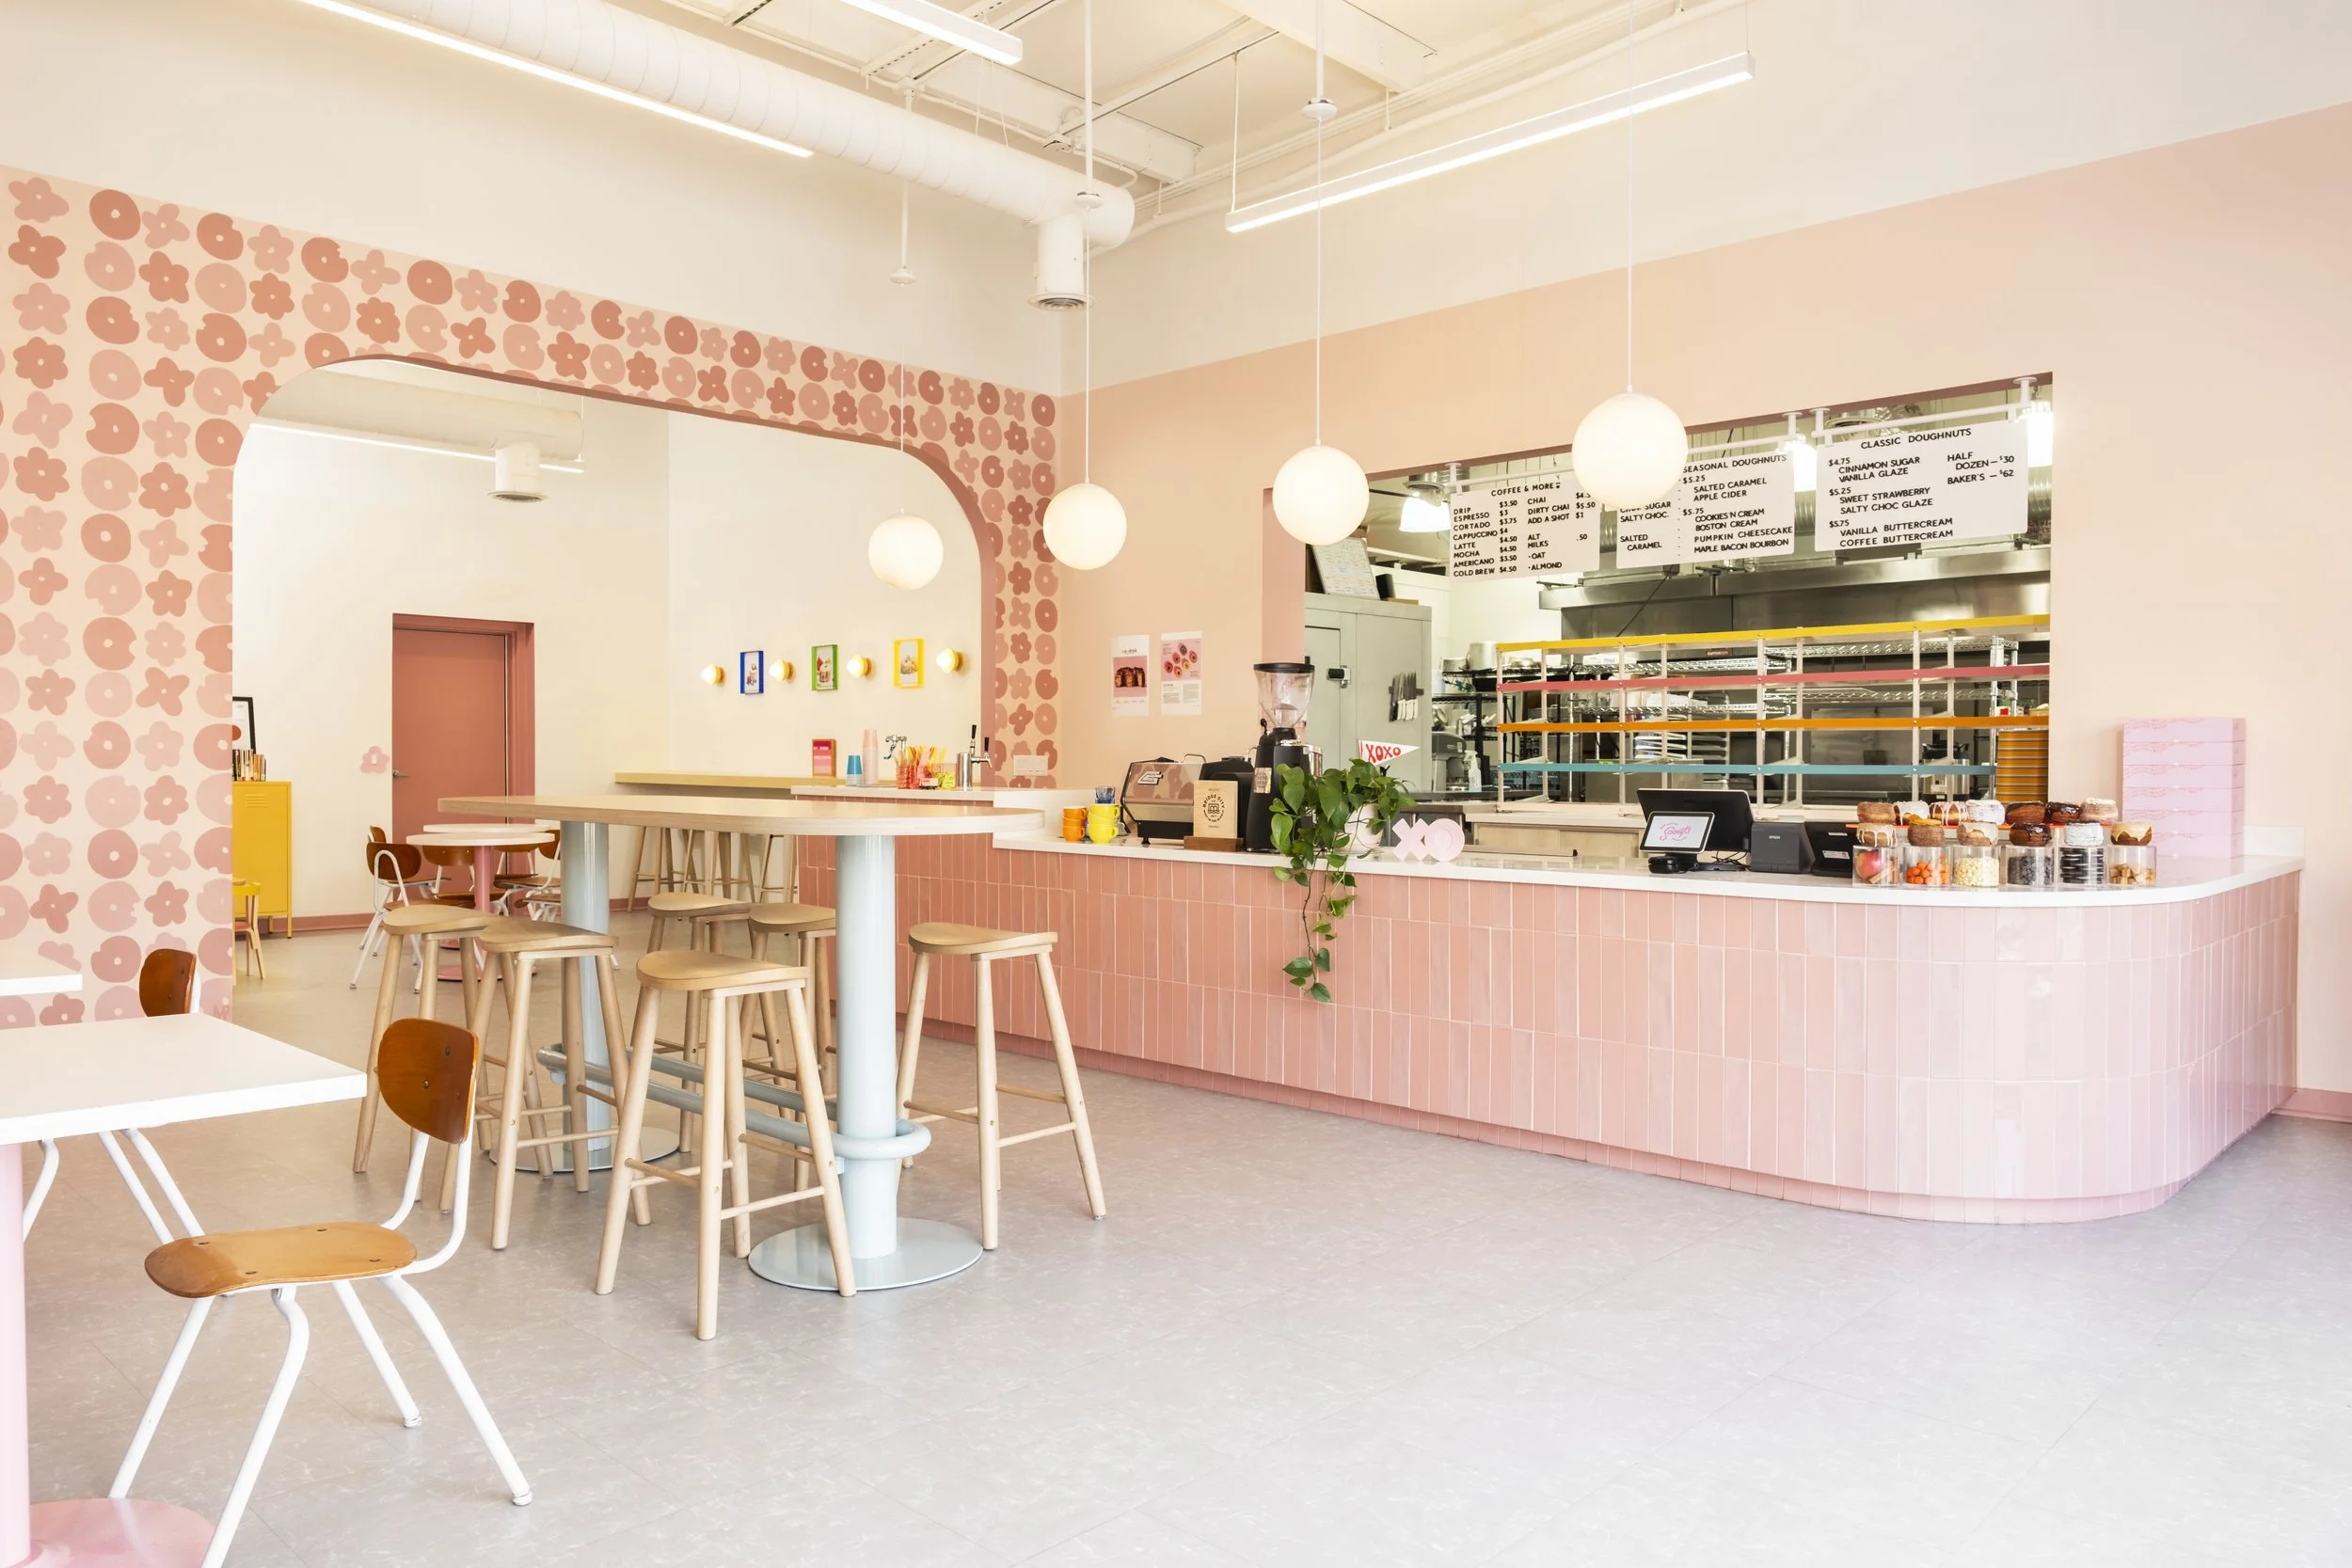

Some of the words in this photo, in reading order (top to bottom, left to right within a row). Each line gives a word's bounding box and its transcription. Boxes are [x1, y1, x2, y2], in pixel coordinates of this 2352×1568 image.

[1861, 436, 1901, 450] CLASSIC
[1908, 428, 1972, 444] DOUGHNUTS
[1828, 457, 1851, 467] $4.75
[1947, 451, 1973, 462] HALF
[1683, 462, 1728, 473] SEASONAL
[1732, 454, 1787, 467] DOUGHNUTS
[1838, 461, 1887, 474] CINNAMON
[1890, 456, 1920, 467] SUGAR
[1956, 459, 1989, 470] DOZEN
[1683, 475, 1706, 484] $5.25
[1839, 471, 1875, 483] VANILLA
[1879, 467, 1909, 478] GLAZE
[1947, 473, 1985, 485] BAKER'S
[1694, 483, 1725, 493] SALTED
[1727, 478, 1768, 489] CARAMEL
[1491, 486, 1521, 497] COFFEE
[1693, 493, 1718, 501] APPLE
[1722, 490, 1747, 499] CIDER
[1829, 487, 1851, 497] $5.25
[1839, 494, 1868, 504] SWEET
[1872, 487, 1931, 500] STRAWBERRY
[1528, 497, 1546, 505] CHAI
[1840, 504, 1868, 515] SALTY
[1871, 502, 1899, 512] CHOC
[1902, 498, 1933, 509] GLAZE
[1454, 507, 1471, 515] DRIP
[1528, 507, 1549, 515] DIRTY
[1576, 501, 1596, 510] $5.50
[1683, 508, 1704, 516] $5.75
[1454, 513, 1489, 523] ESPRESSO
[1620, 514, 1644, 523] SALTY
[1695, 513, 1728, 523] COOKIES
[1738, 508, 1765, 518] CREAM
[1454, 522, 1490, 531] CORTADO
[1695, 522, 1726, 531] BOSTON
[1730, 519, 1757, 528] CREAM
[1829, 519, 1850, 529] $5.75
[1840, 526, 1878, 537] VANILLA
[1883, 517, 1953, 532] BUTTERCREAM
[1454, 531, 1498, 541] CAPPUCCINO
[1620, 534, 1648, 543] SALTED
[1694, 533, 1733, 543] PUMPKIN
[1738, 527, 1793, 538] CHEESECAKE
[1840, 537, 1878, 547] COFFEE
[1883, 530, 1954, 544] BUTTERCREAM
[1454, 542, 1476, 550] LATTE
[1528, 541, 1549, 549] MILKS
[1628, 542, 1662, 551] CARAMEL
[1694, 545, 1718, 553] MAPLE
[1721, 543, 1748, 551] BACON
[1750, 539, 1788, 548] BOURBON
[1454, 558, 1494, 568] AMERICANO
[1366, 744, 1401, 763] XOXO
